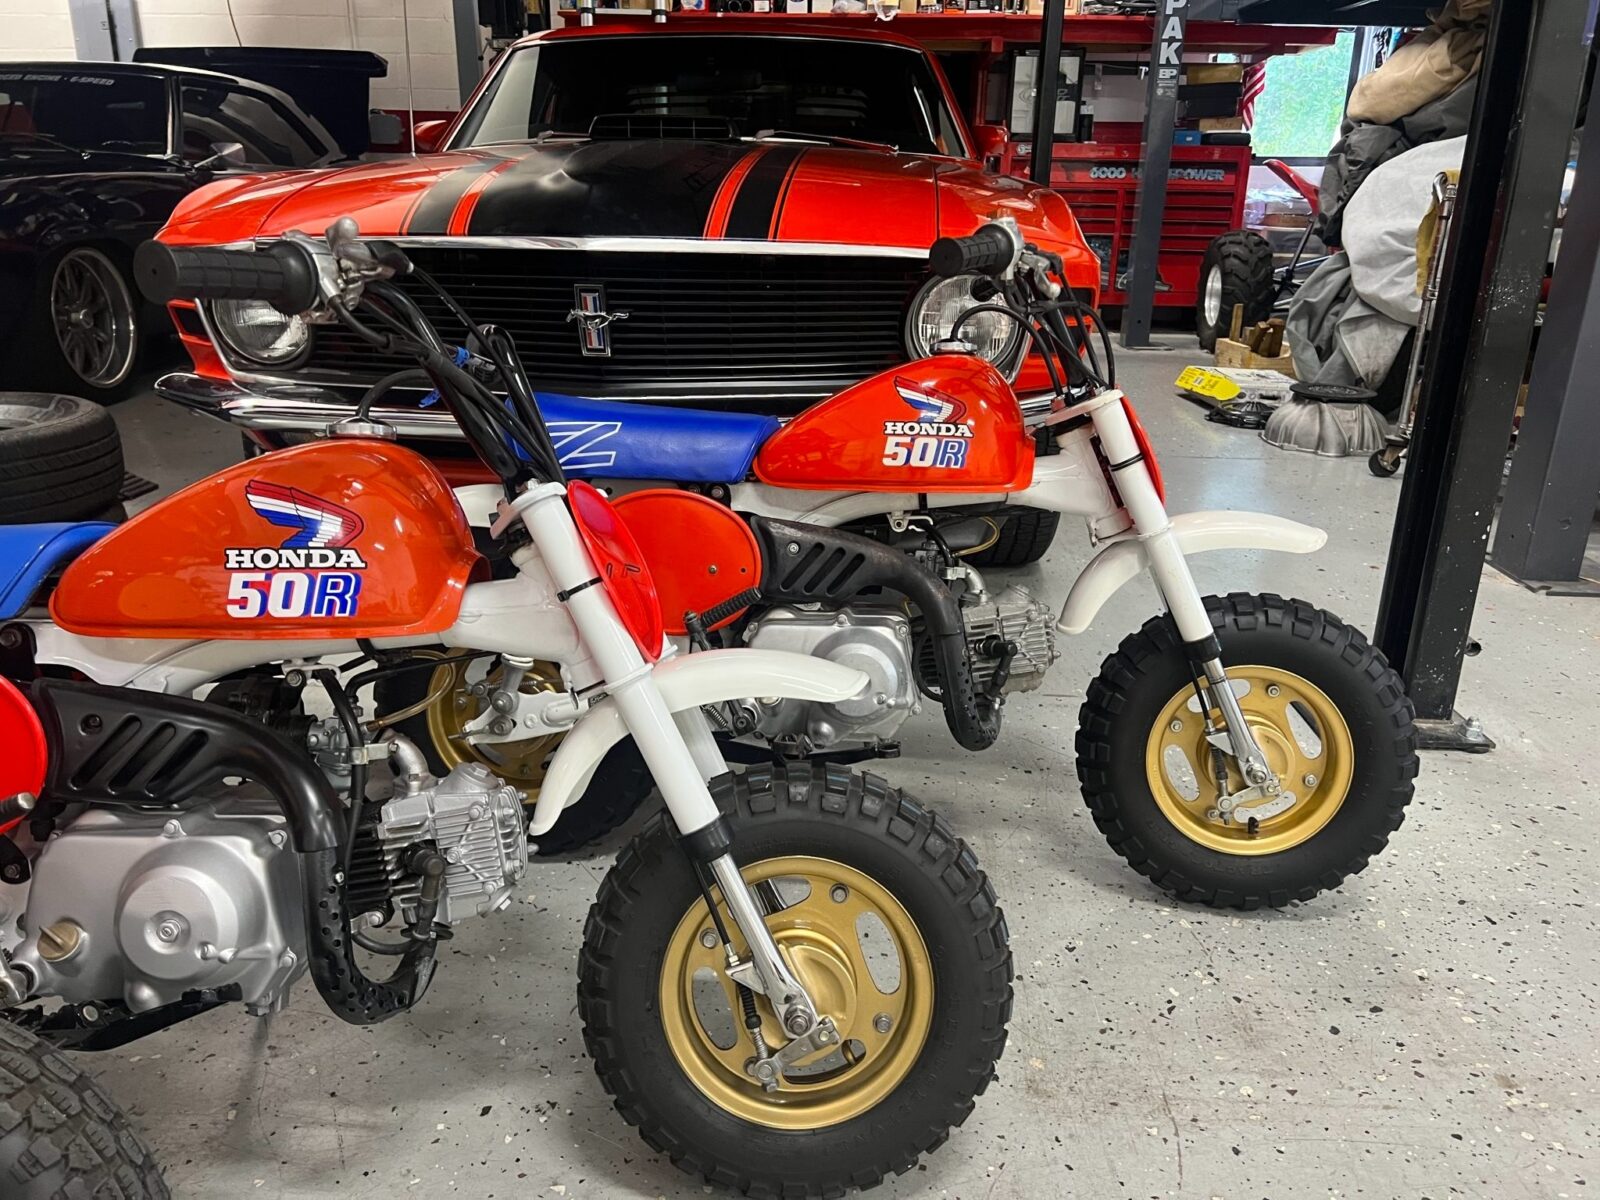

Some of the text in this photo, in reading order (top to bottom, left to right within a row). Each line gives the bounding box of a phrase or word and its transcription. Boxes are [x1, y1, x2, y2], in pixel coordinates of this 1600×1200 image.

[1159, 0, 1187, 65] PAK
[884, 421, 974, 438] HONDA
[882, 436, 969, 469] 50R
[225, 548, 367, 569] HONDA
[226, 572, 363, 618] 50R
